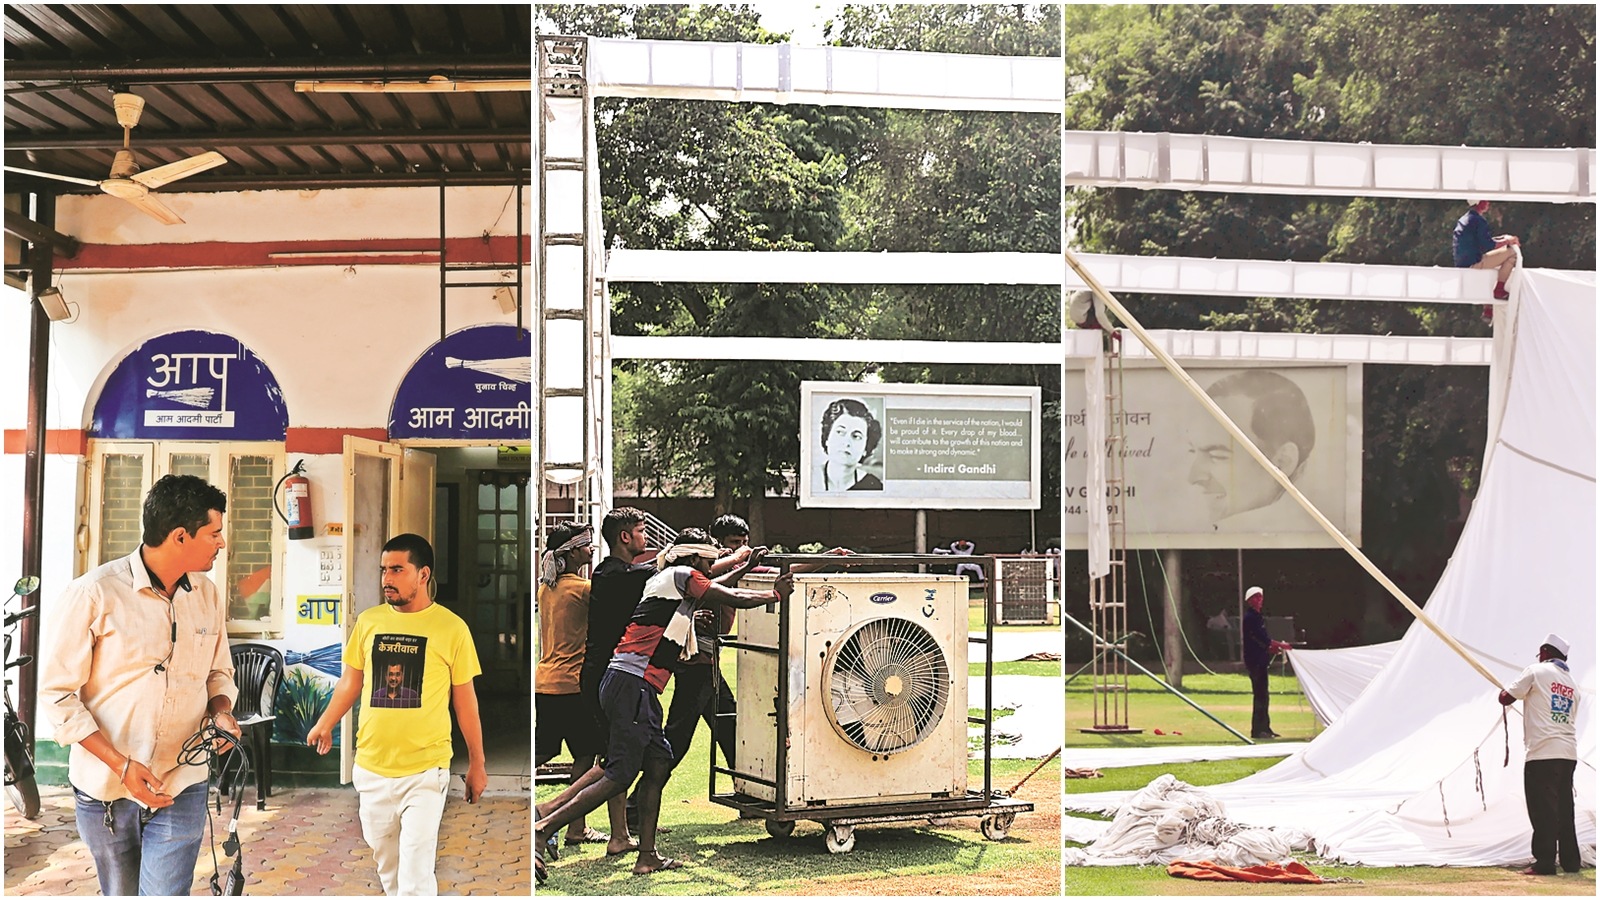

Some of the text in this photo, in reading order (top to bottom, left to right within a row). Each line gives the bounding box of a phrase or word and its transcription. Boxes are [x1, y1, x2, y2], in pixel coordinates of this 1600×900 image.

[147, 353, 237, 411] आप
[475, 381, 517, 393] चुनाव चिन्ह
[155, 413, 223, 424] आम आदमी पार्टी
[408, 401, 531, 429] आम आदमी
[916, 417, 926, 425] die
[933, 417, 942, 425] the
[963, 417, 970, 425] of
[970, 418, 980, 426] the
[1005, 418, 1023, 427] would
[890, 427, 898, 435] be
[901, 427, 919, 437] proud
[922, 427, 929, 435] of
[941, 428, 958, 437] Every
[961, 427, 976, 437] drop
[978, 427, 985, 436] of
[987, 430, 997, 438] my
[890, 437, 901, 445] will
[901, 437, 931, 445] contribute
[940, 437, 949, 445] the
[950, 438, 971, 447] growth
[972, 437, 979, 446] of
[980, 438, 990, 446] this
[991, 439, 1010, 447] nation
[1010, 438, 1023, 447] and
[896, 447, 913, 455] make
[918, 448, 937, 457] strong
[937, 447, 950, 456] and
[924, 463, 954, 474] Indira
[957, 463, 996, 474] Gandhi
[1079, 486, 1136, 498] GNDHI
[298, 598, 341, 625] आप
[378, 641, 419, 654] केजरीवाल
[1551, 682, 1574, 699] भारत
